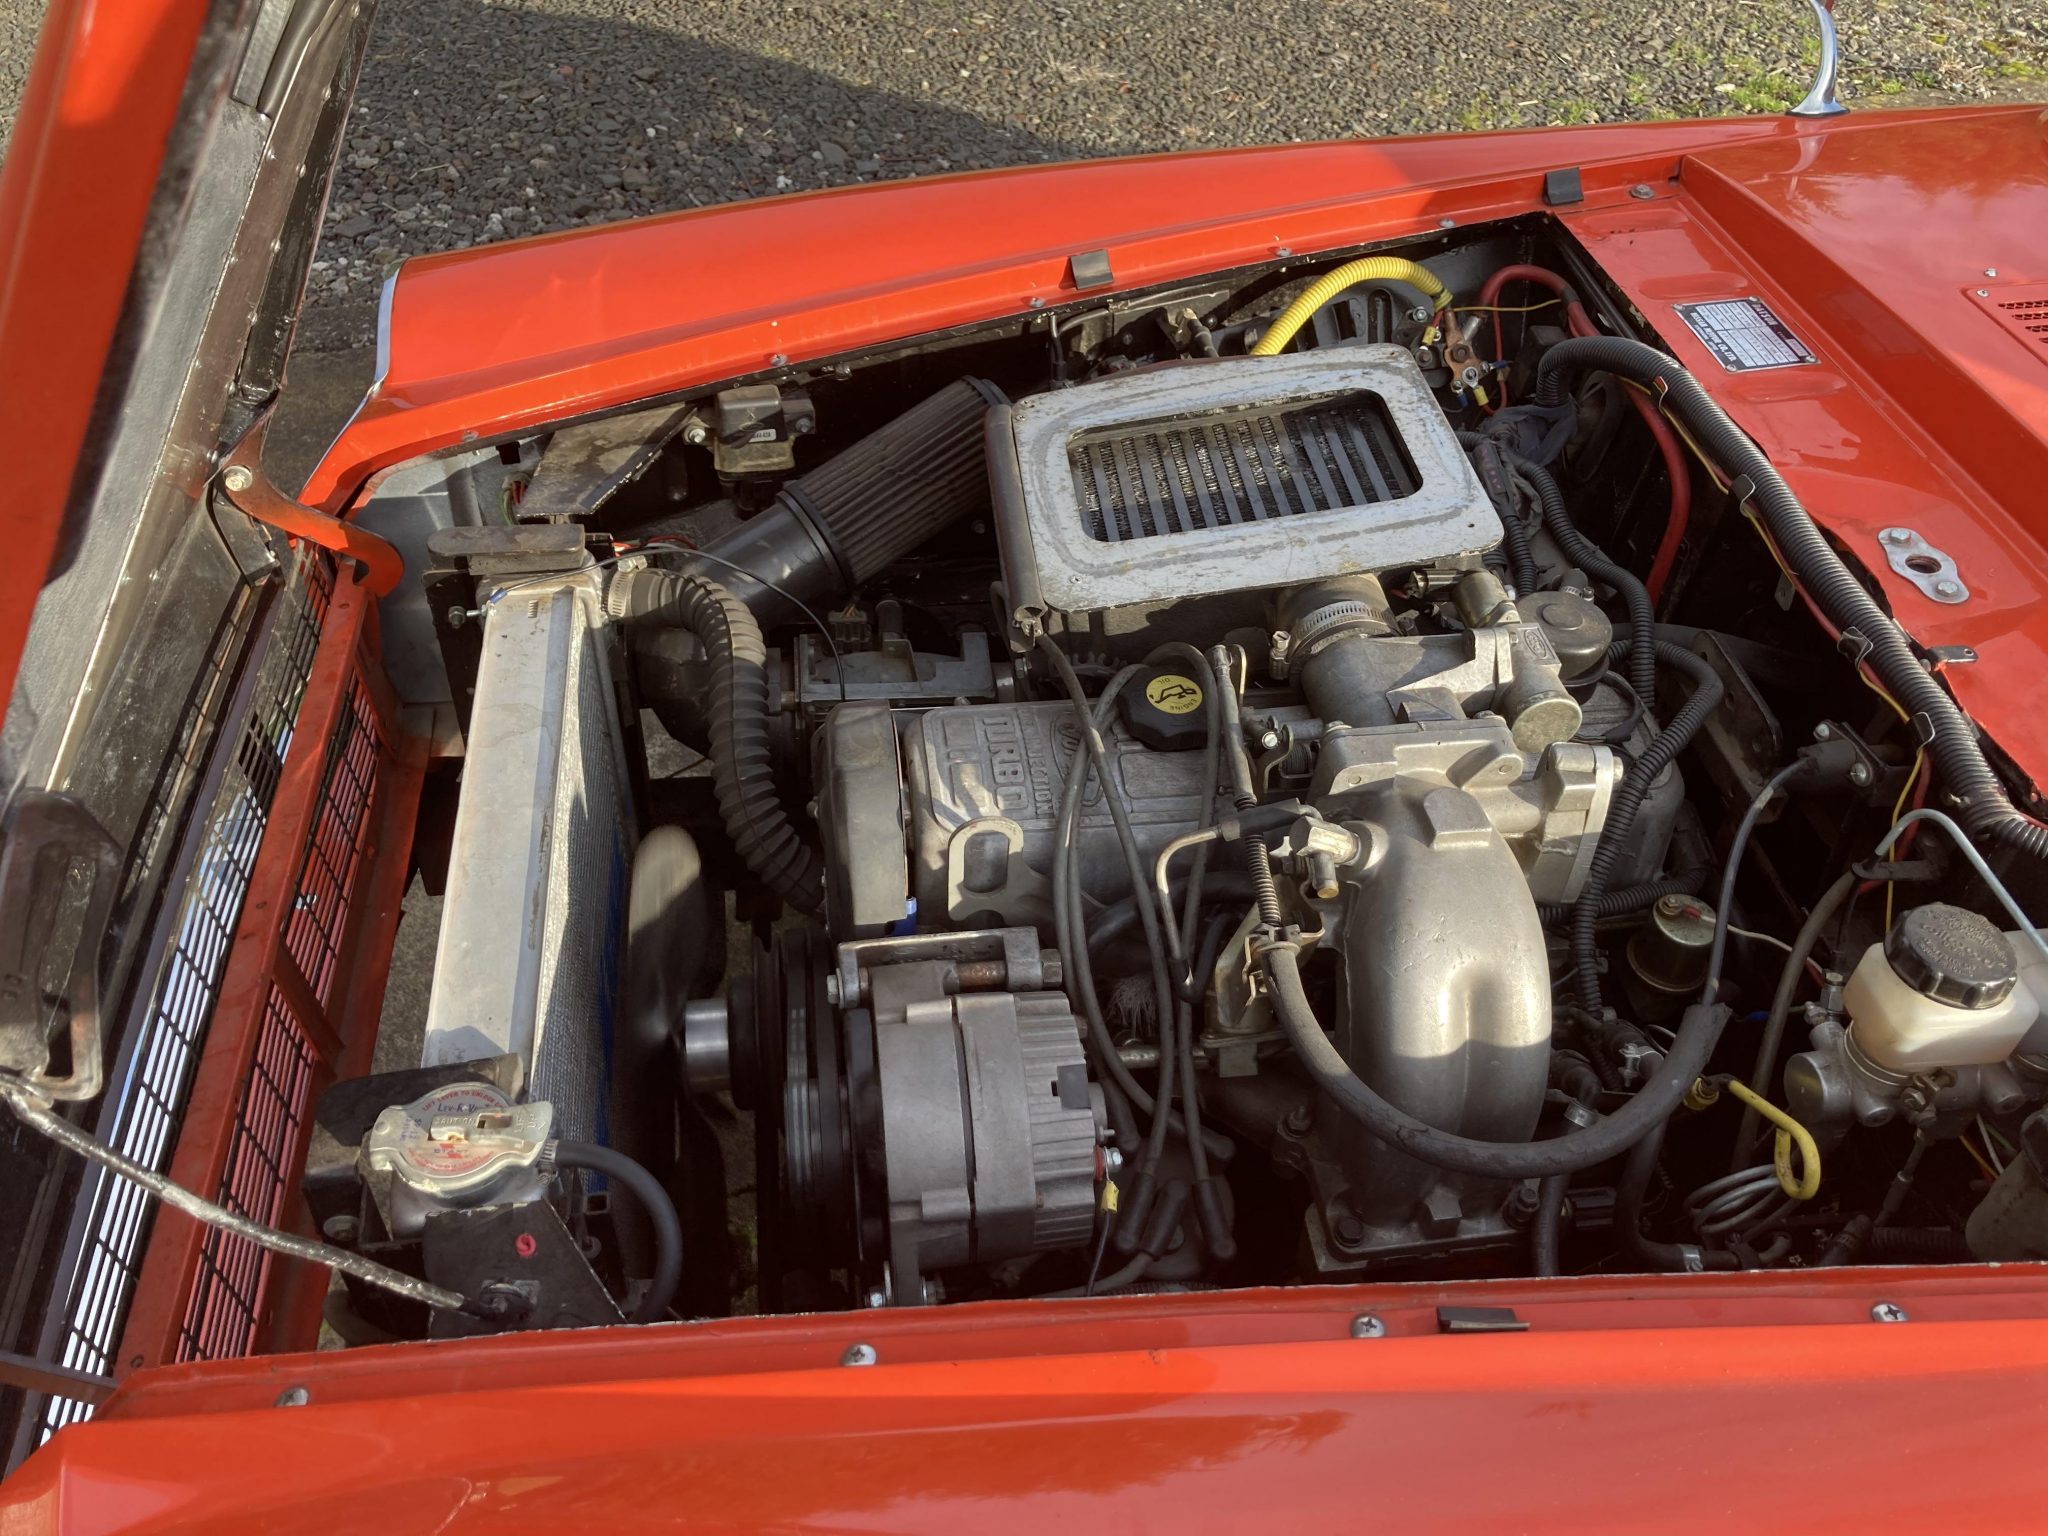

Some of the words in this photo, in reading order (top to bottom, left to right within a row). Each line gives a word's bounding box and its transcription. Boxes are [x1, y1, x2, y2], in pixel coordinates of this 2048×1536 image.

[1751, 303, 1779, 326] DATSUN
[1157, 677, 1170, 685] OIL
[1169, 698, 1197, 711] ENGINE
[983, 716, 1029, 811] TURBO
[1025, 736, 1053, 816] INJECTION
[460, 1089, 470, 1097] TO
